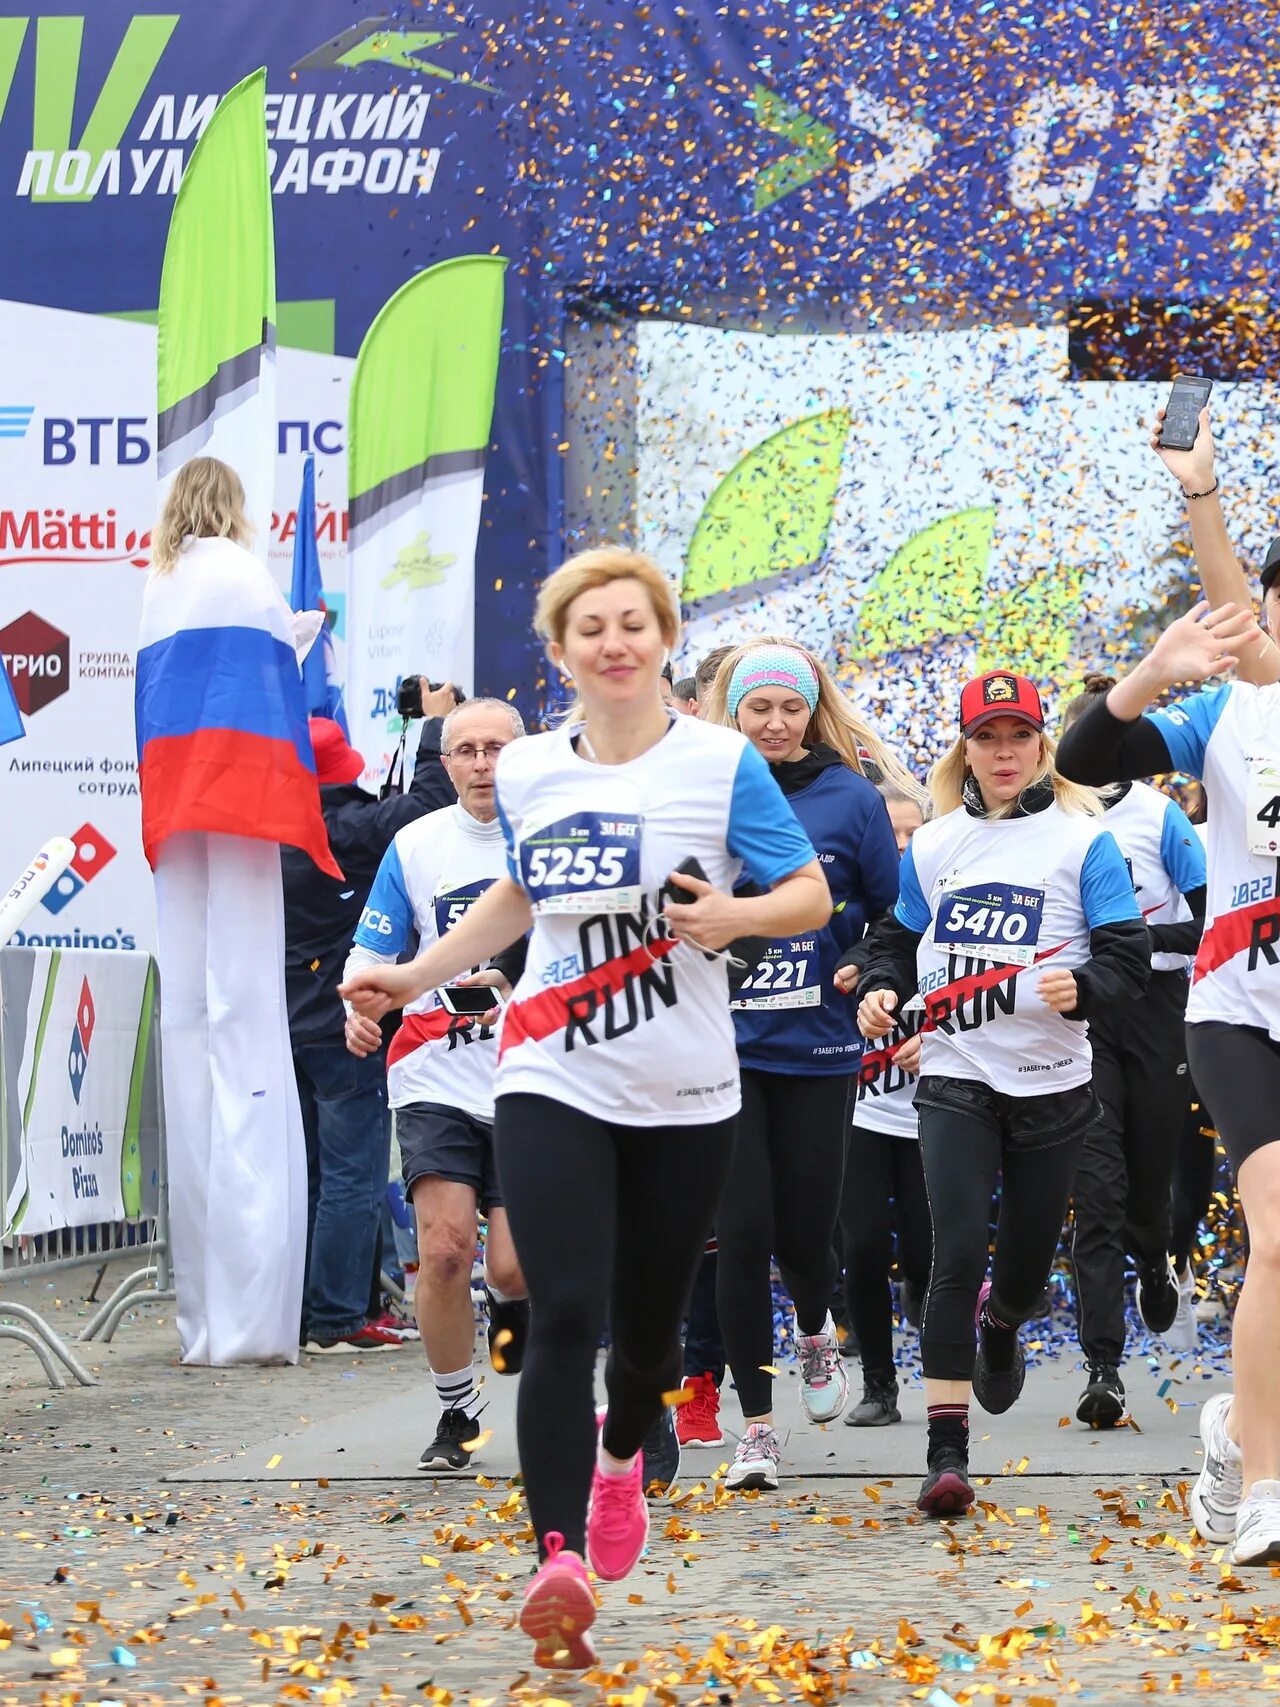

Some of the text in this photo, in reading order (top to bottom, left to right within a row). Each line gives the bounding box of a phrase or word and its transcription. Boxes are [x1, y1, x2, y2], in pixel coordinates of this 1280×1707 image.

[0, 15, 181, 203] V
[138, 85, 431, 143] ЛИЕЦКИЙ
[16, 148, 441, 196] ПОЛУАФОН
[43, 418, 150, 465] ВТБ
[0, 509, 116, 549] Mätti
[79, 653, 130, 664] ГРУППА
[9, 757, 139, 774] Липецкий фон
[527, 847, 628, 887] 5255
[6, 928, 136, 951] Domino's
[945, 903, 1027, 942] 5410
[565, 952, 678, 1053] RUN
[928, 973, 1017, 1036] RUN
[812, 1046, 843, 1055] #ЗАБЕГРФ
[1018, 1063, 1050, 1073] #ЗАБЕГРФ
[61, 1122, 103, 1158] Domino's
[72, 1165, 99, 1199] Pizza
